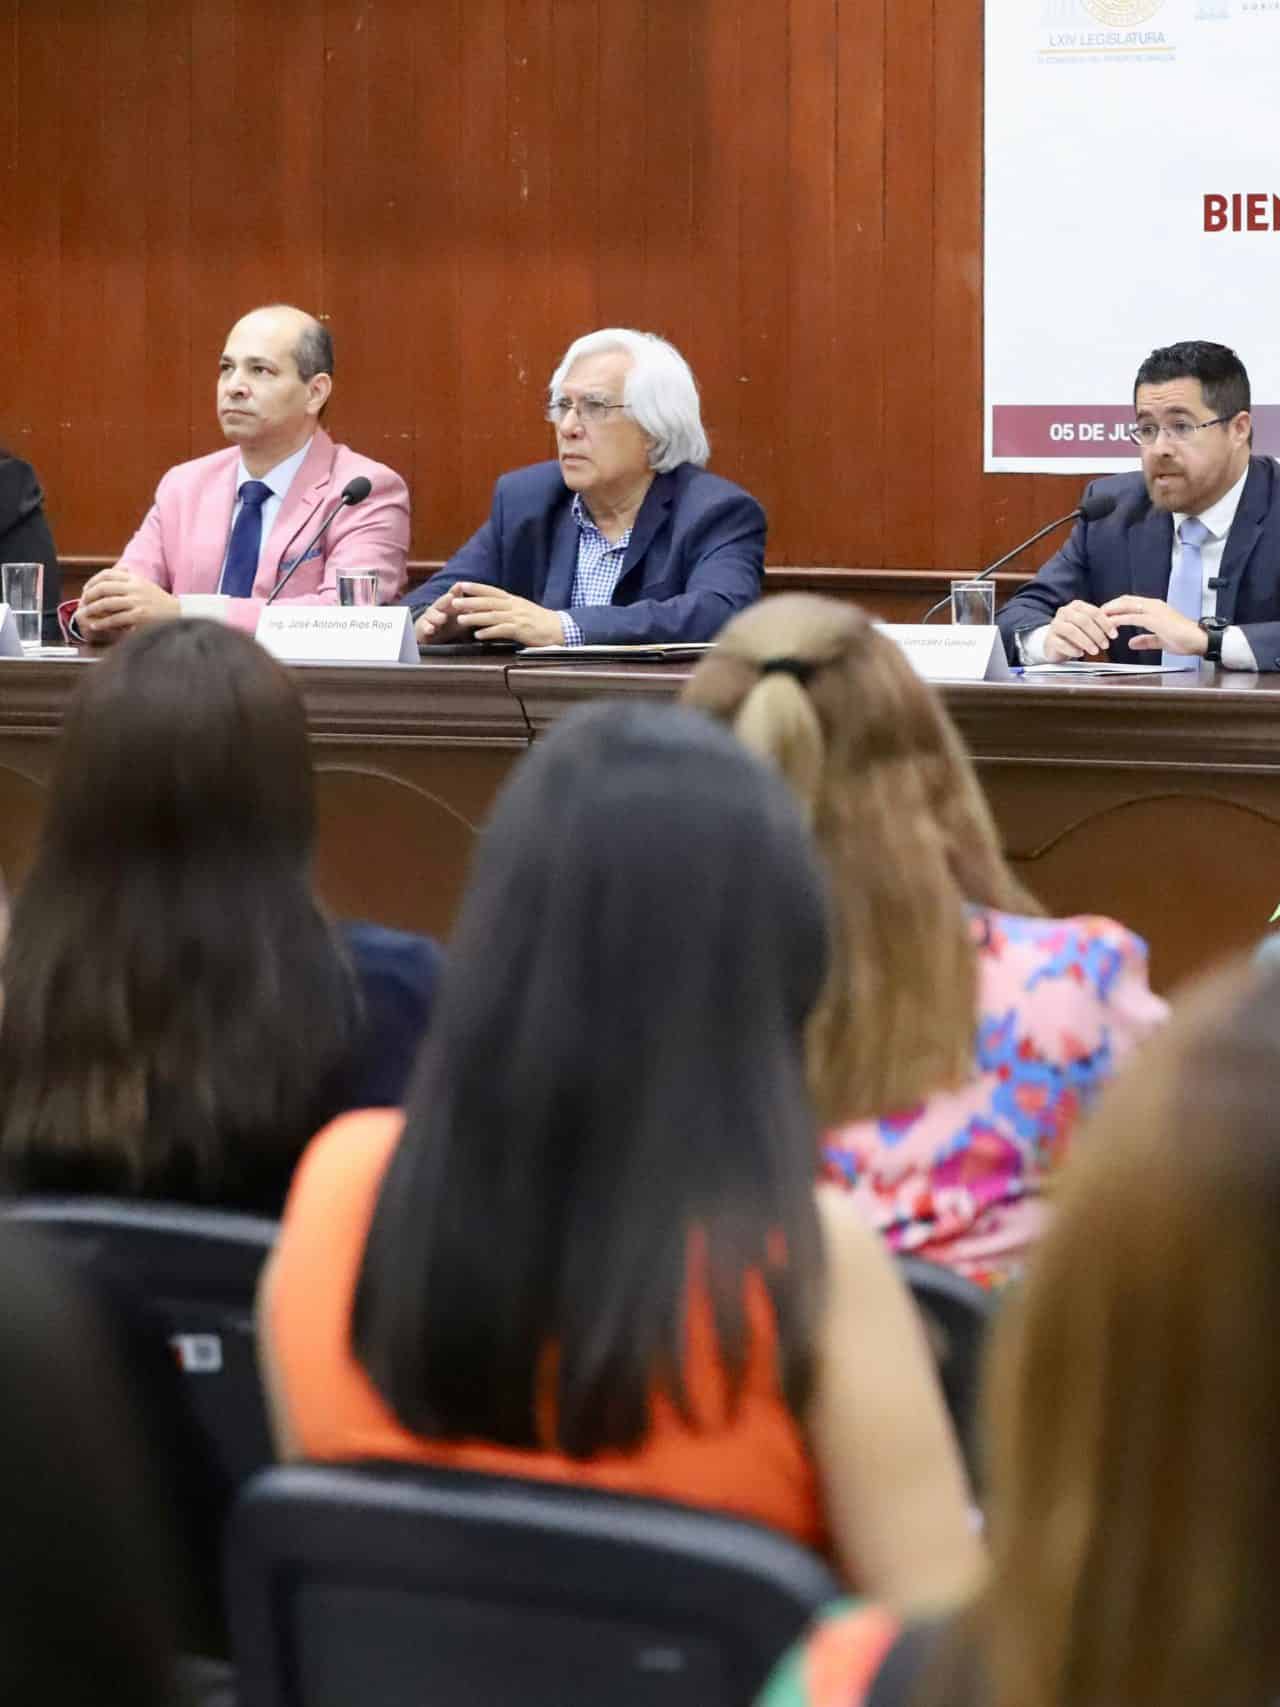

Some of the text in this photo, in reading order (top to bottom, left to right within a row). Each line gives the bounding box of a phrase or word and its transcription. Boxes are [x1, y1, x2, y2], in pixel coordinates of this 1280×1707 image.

[1079, 31, 1167, 47] LEGISLATURA
[1050, 423, 1138, 441] 05 DE JU
